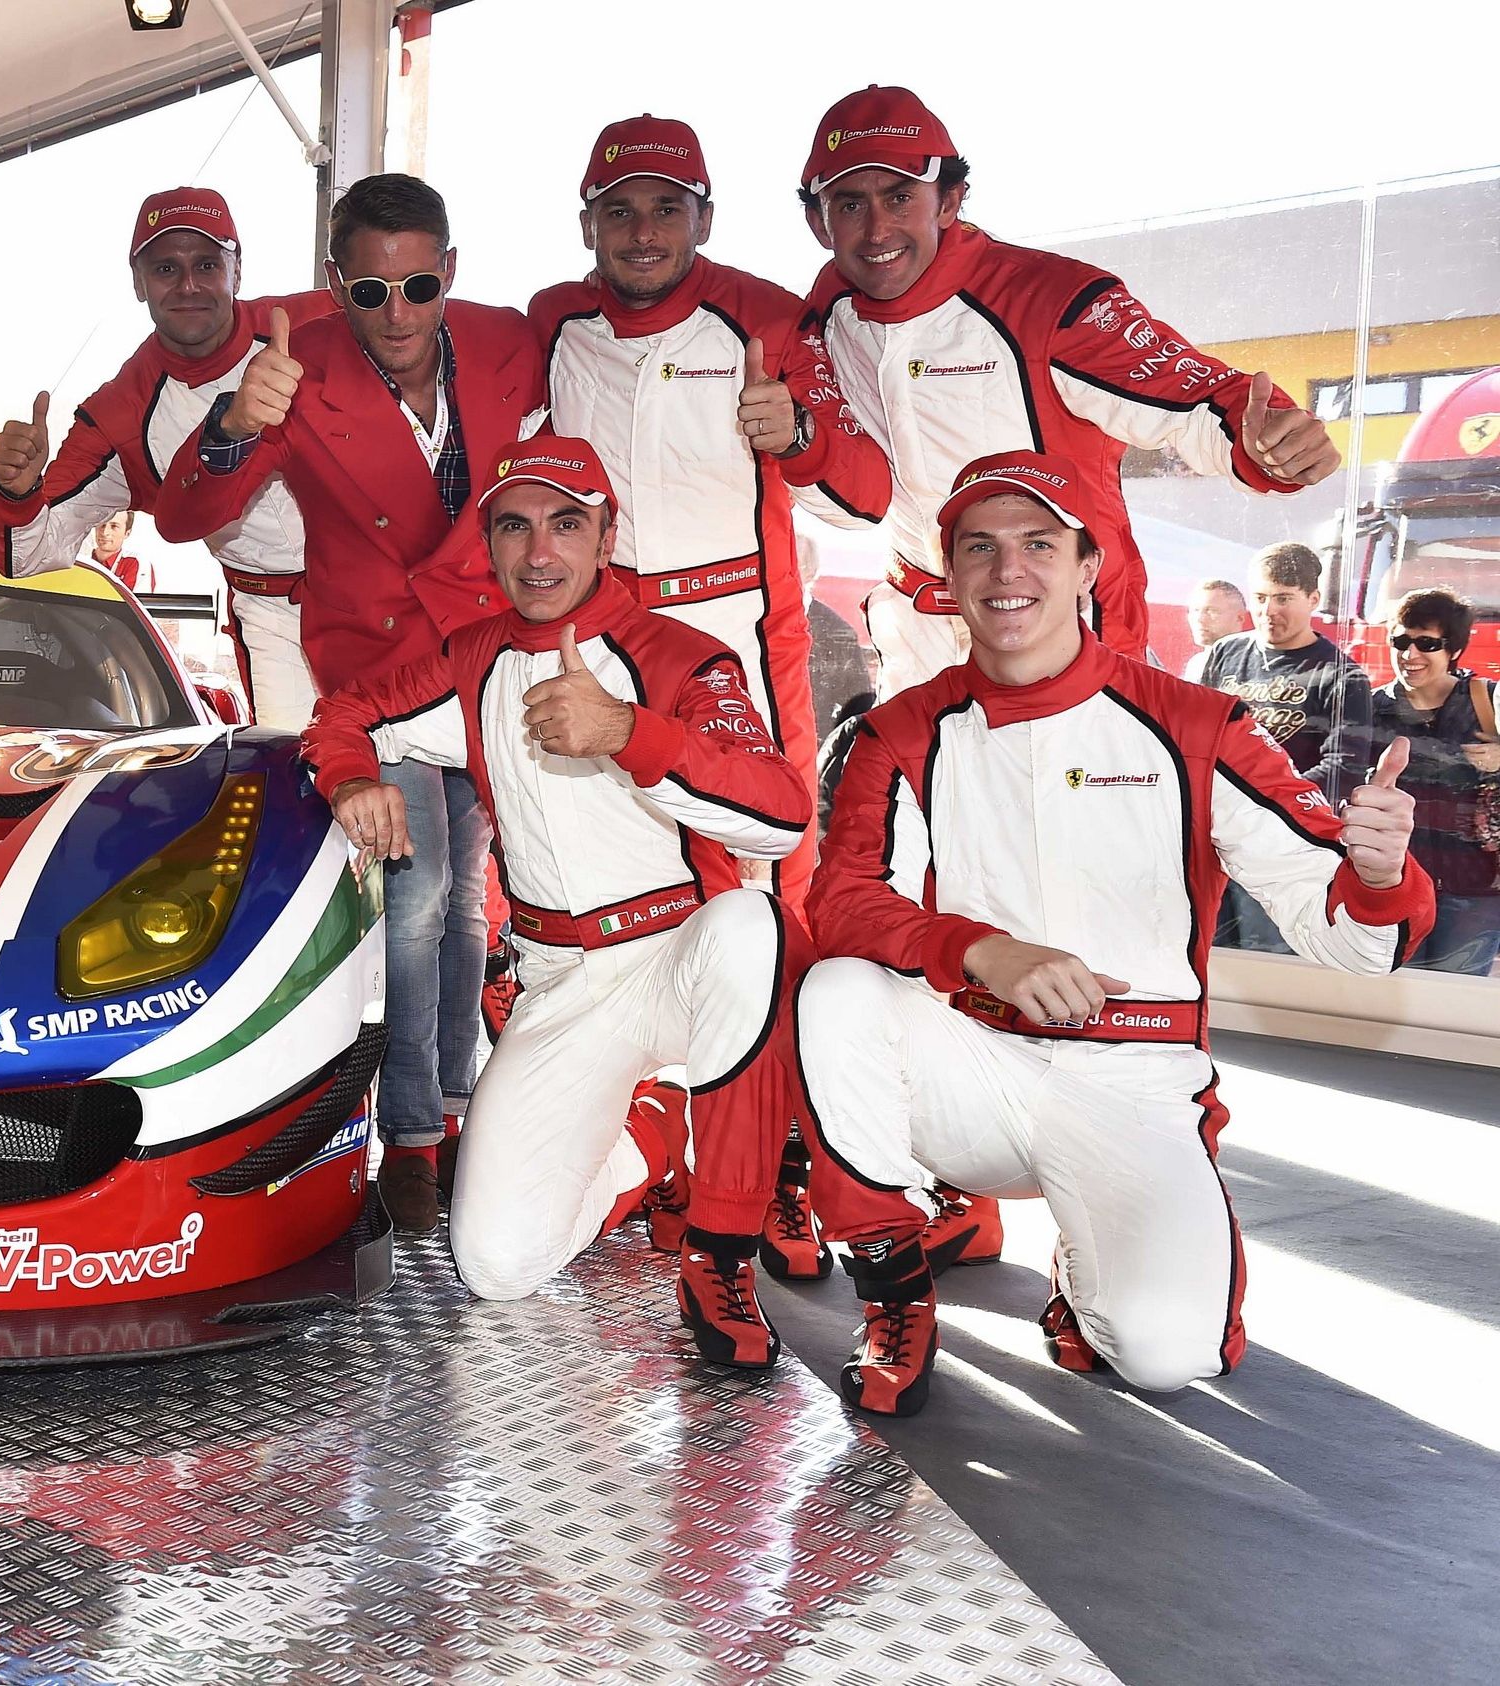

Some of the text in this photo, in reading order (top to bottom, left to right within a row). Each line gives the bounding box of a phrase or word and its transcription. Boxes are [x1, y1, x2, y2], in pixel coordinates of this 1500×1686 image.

[843, 124, 922, 140] Competizioni GT
[620, 142, 689, 157] Competizioni GT
[161, 205, 222, 217] Competizioni GT
[924, 360, 998, 376] Competizioni GT
[1129, 340, 1190, 381] SING
[675, 366, 730, 378] Competizioni
[511, 455, 586, 470] Competizioni GT
[980, 465, 1069, 488] Competizioni GT
[691, 566, 757, 590] G. Fisichella
[1146, 773, 1161, 783] GT
[632, 911, 647, 924] A.
[27, 979, 210, 1041] SMP RACING
[970, 998, 1002, 1014] Sabelt
[1088, 1012, 1171, 1028] J. Calado
